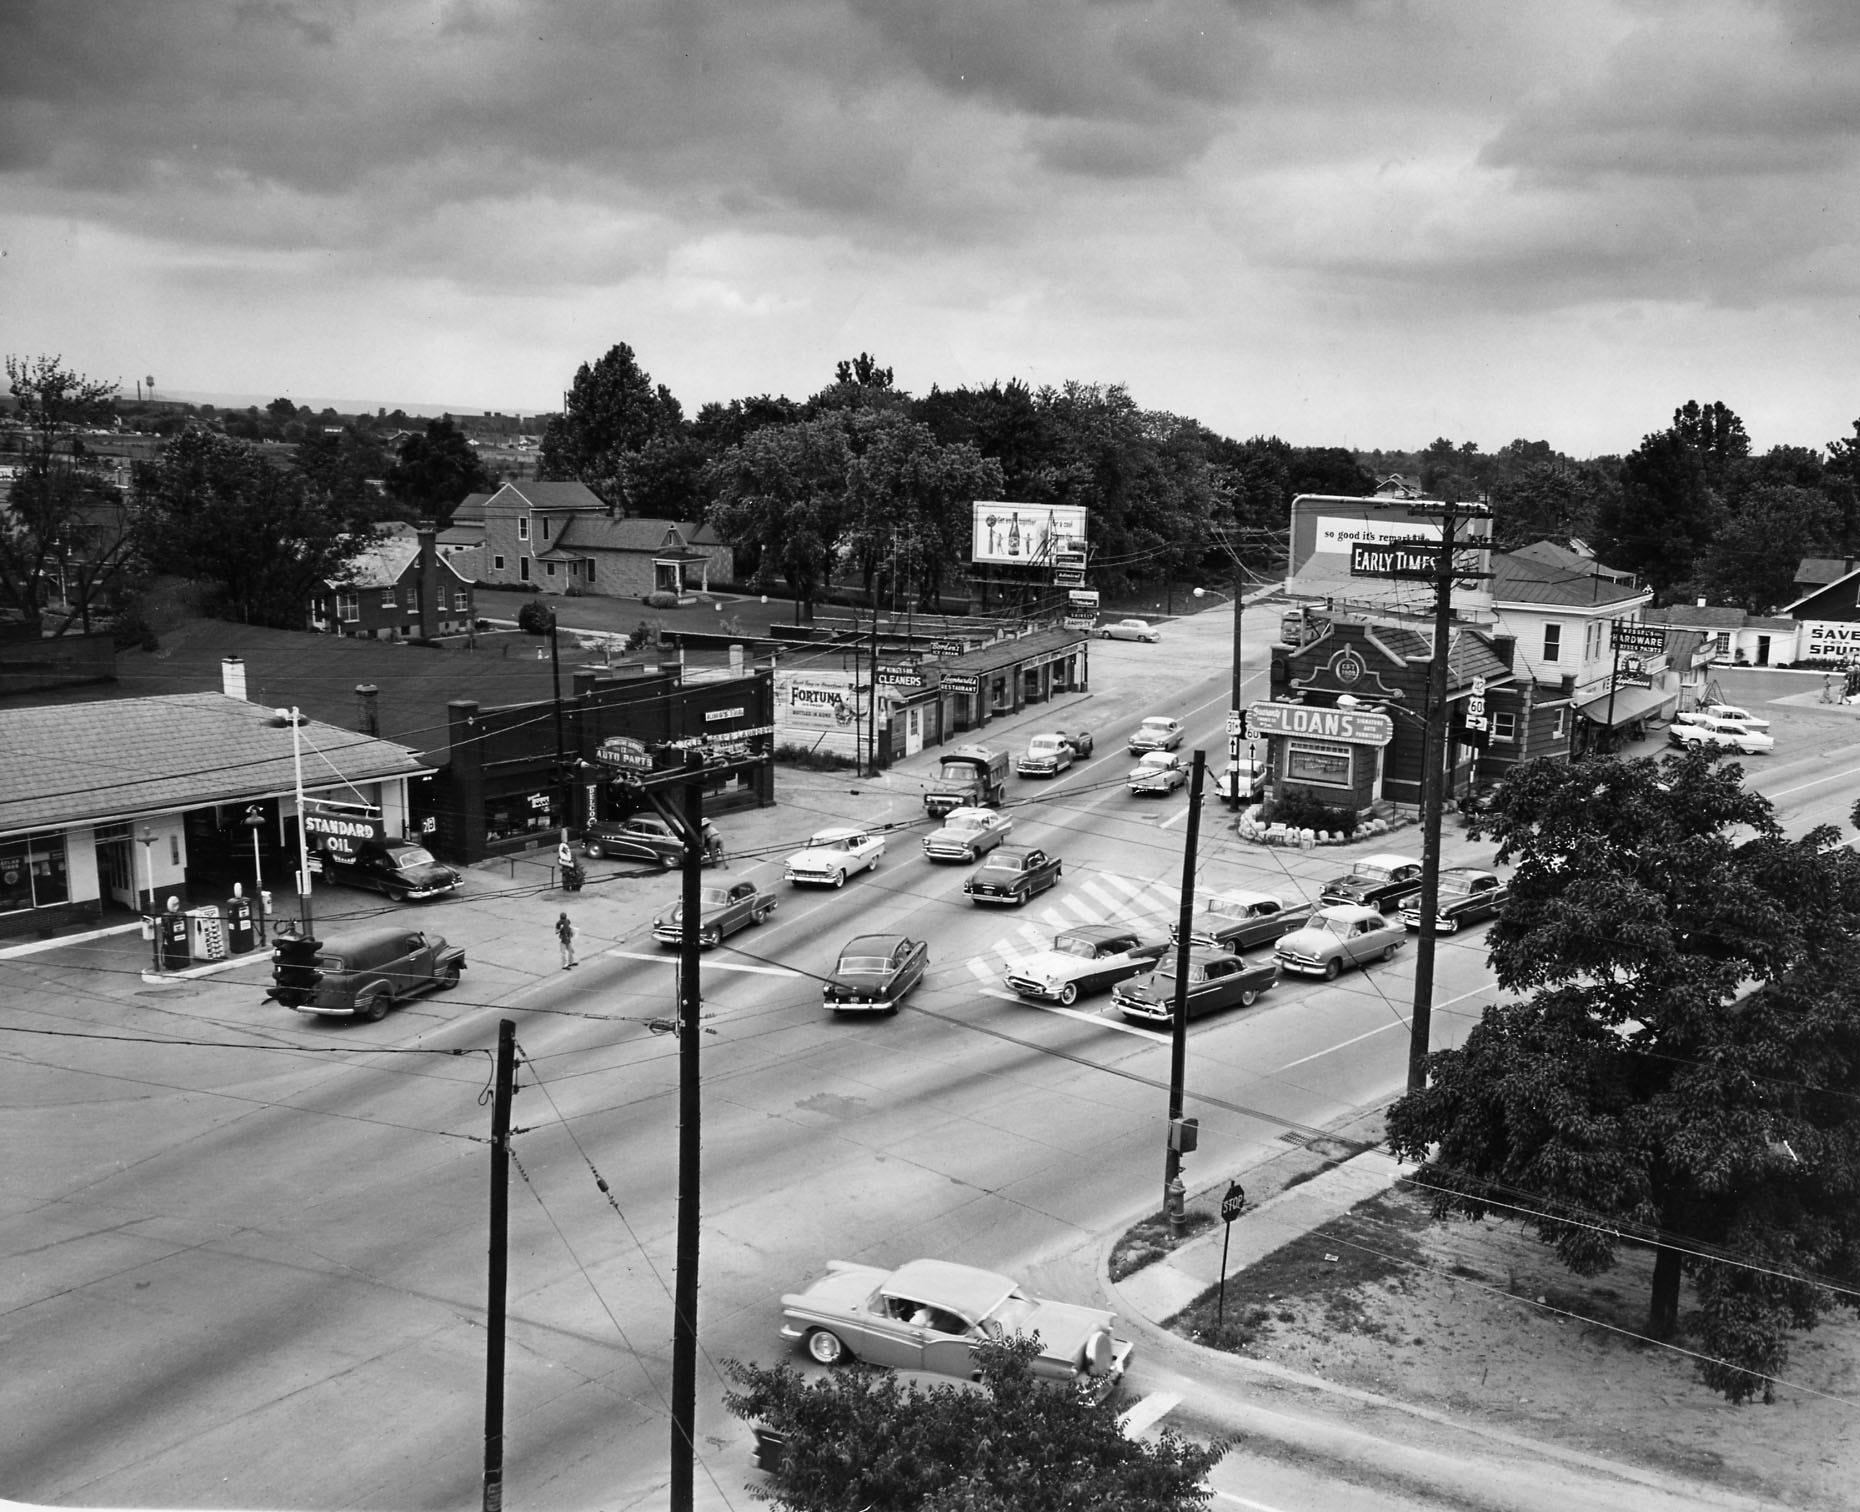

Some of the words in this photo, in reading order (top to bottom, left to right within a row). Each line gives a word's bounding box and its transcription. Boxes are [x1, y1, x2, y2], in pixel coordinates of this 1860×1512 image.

[1337, 531, 1360, 542] good
[1362, 531, 1375, 540] it's
[1354, 548, 1394, 572] EARLY
[1612, 633, 1664, 647] HARDWARE
[1811, 629, 1860, 640] SAVE
[878, 674, 922, 687] CLEANERS
[790, 686, 843, 706] FORTUNA
[940, 684, 977, 693] RESTAURANT
[1471, 701, 1483, 713] 60
[1281, 709, 1353, 738] LOANS
[1247, 728, 1259, 739] 60
[596, 749, 620, 762] AUTO
[623, 753, 653, 768] PARTS
[305, 816, 374, 839] STANDARD
[327, 836, 353, 853] OIL
[1223, 1194, 1243, 1214] STOP
